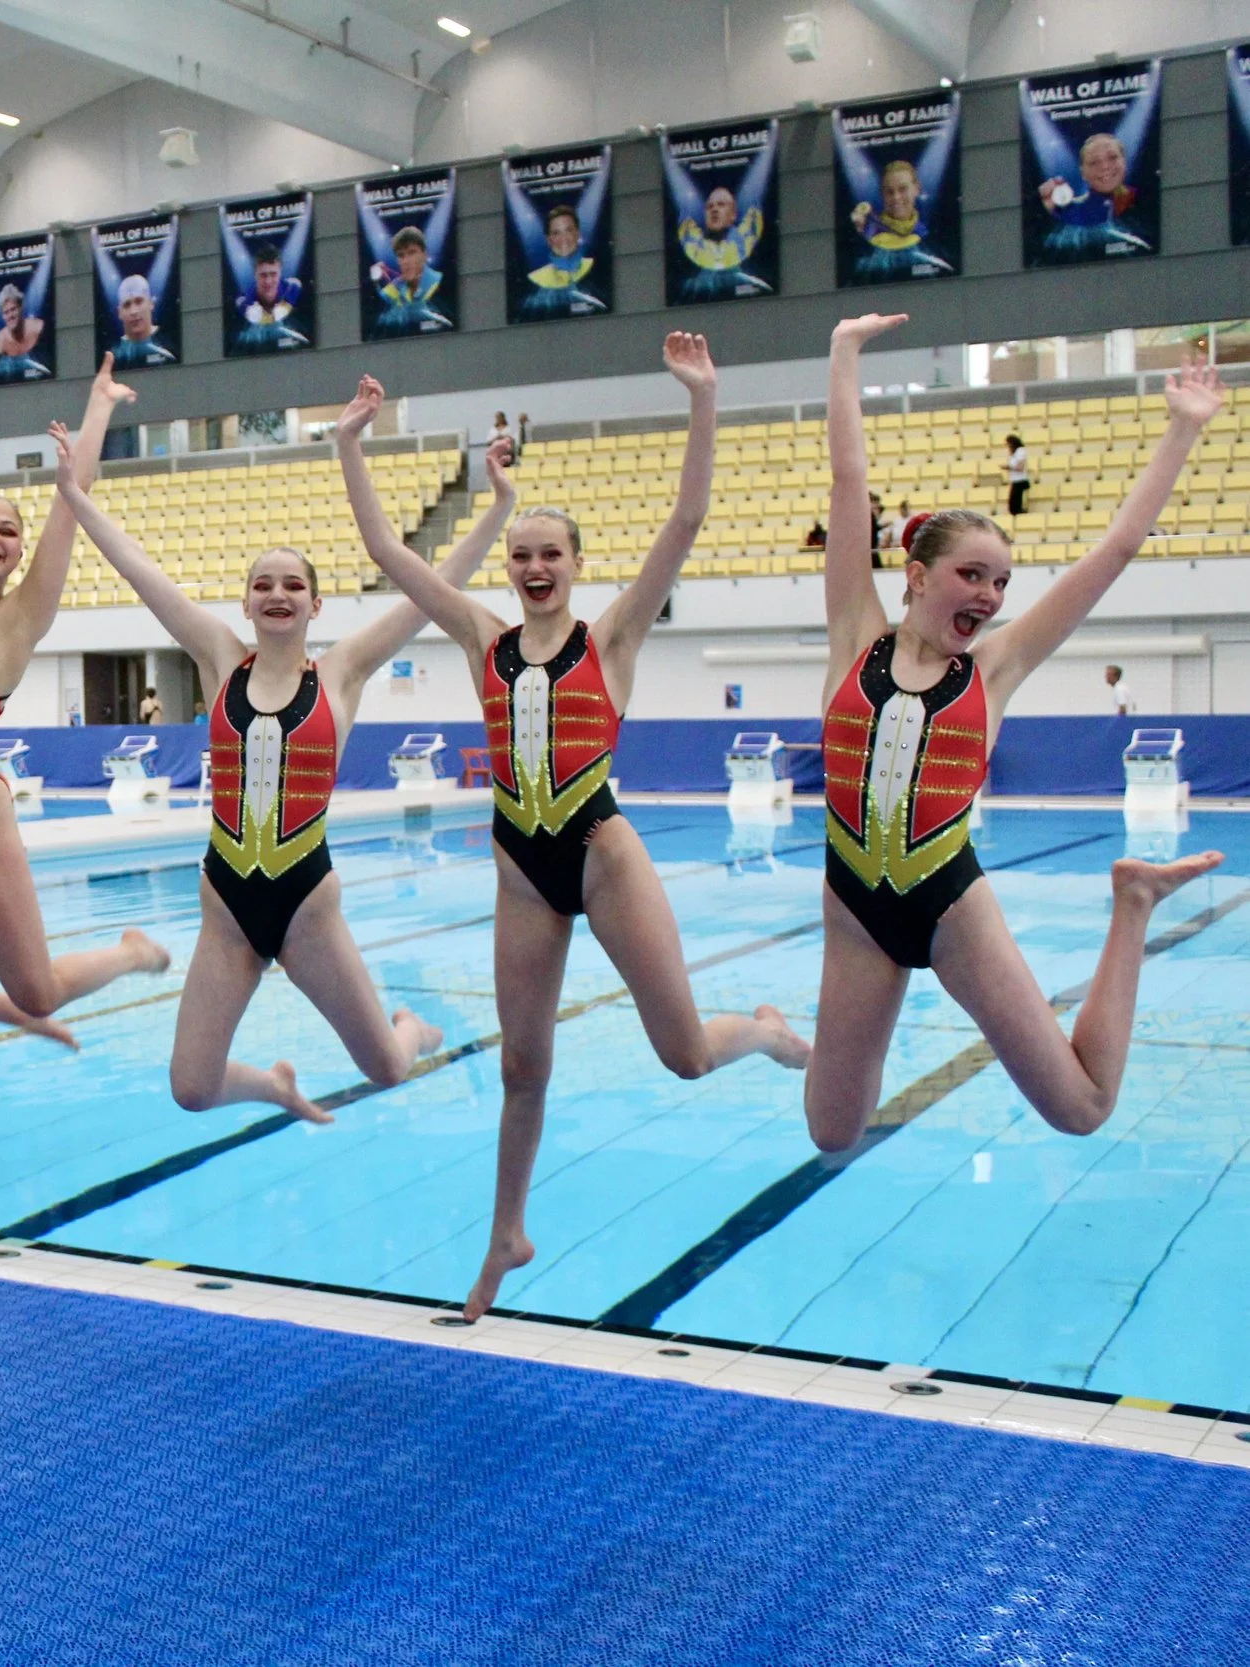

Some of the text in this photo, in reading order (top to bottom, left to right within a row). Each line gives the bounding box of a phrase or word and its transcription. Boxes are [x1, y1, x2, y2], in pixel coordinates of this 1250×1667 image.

[1030, 73, 1149, 104] WALL OF FAME
[842, 103, 950, 130] WALL OF FAME
[670, 130, 768, 155] WALL OF FAME
[510, 156, 603, 179] WALL OF FAME
[364, 179, 449, 201] WALL OF FAME
[226, 201, 305, 223] WALL OF FAME
[99, 223, 171, 243] WALL OF FAME
[6, 248, 19, 259] OF
[21, 243, 47, 256] FAME
